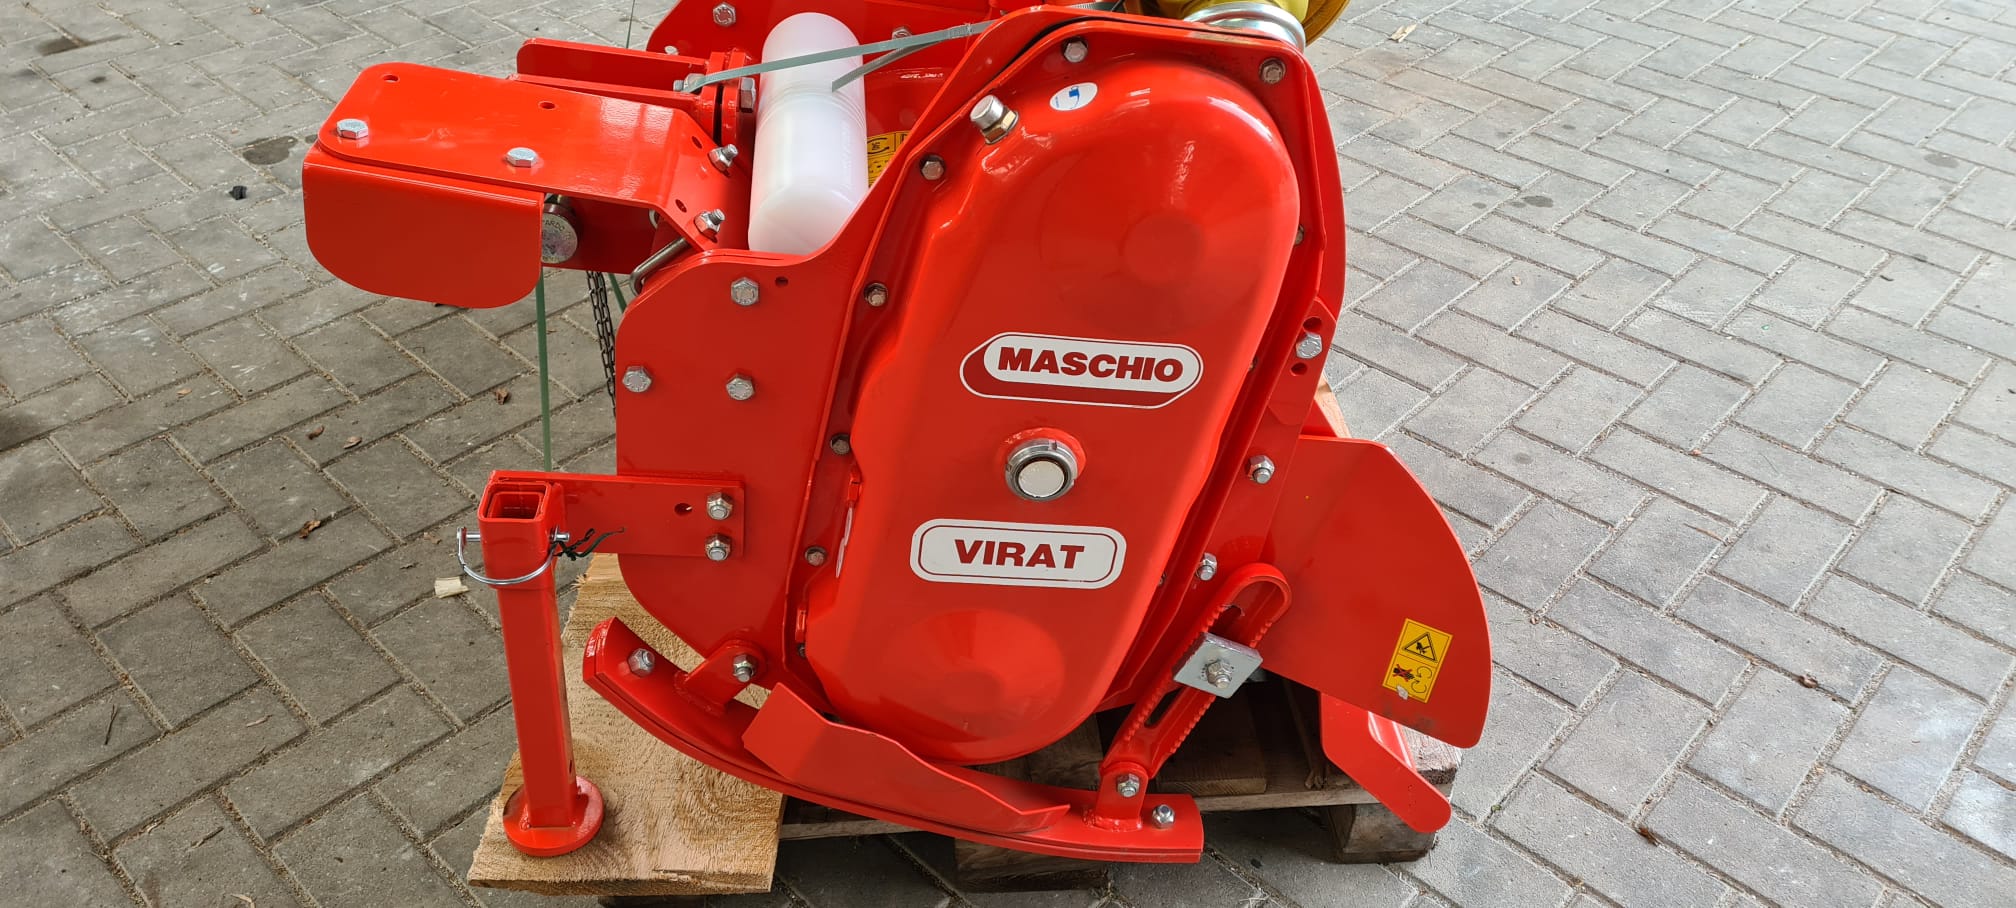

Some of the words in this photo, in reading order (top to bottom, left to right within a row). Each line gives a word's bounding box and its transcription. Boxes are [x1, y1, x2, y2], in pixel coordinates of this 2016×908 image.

[542, 219, 566, 232] ARDO
[997, 346, 1184, 383] MASCHIO
[954, 539, 1085, 569] VIRAT
